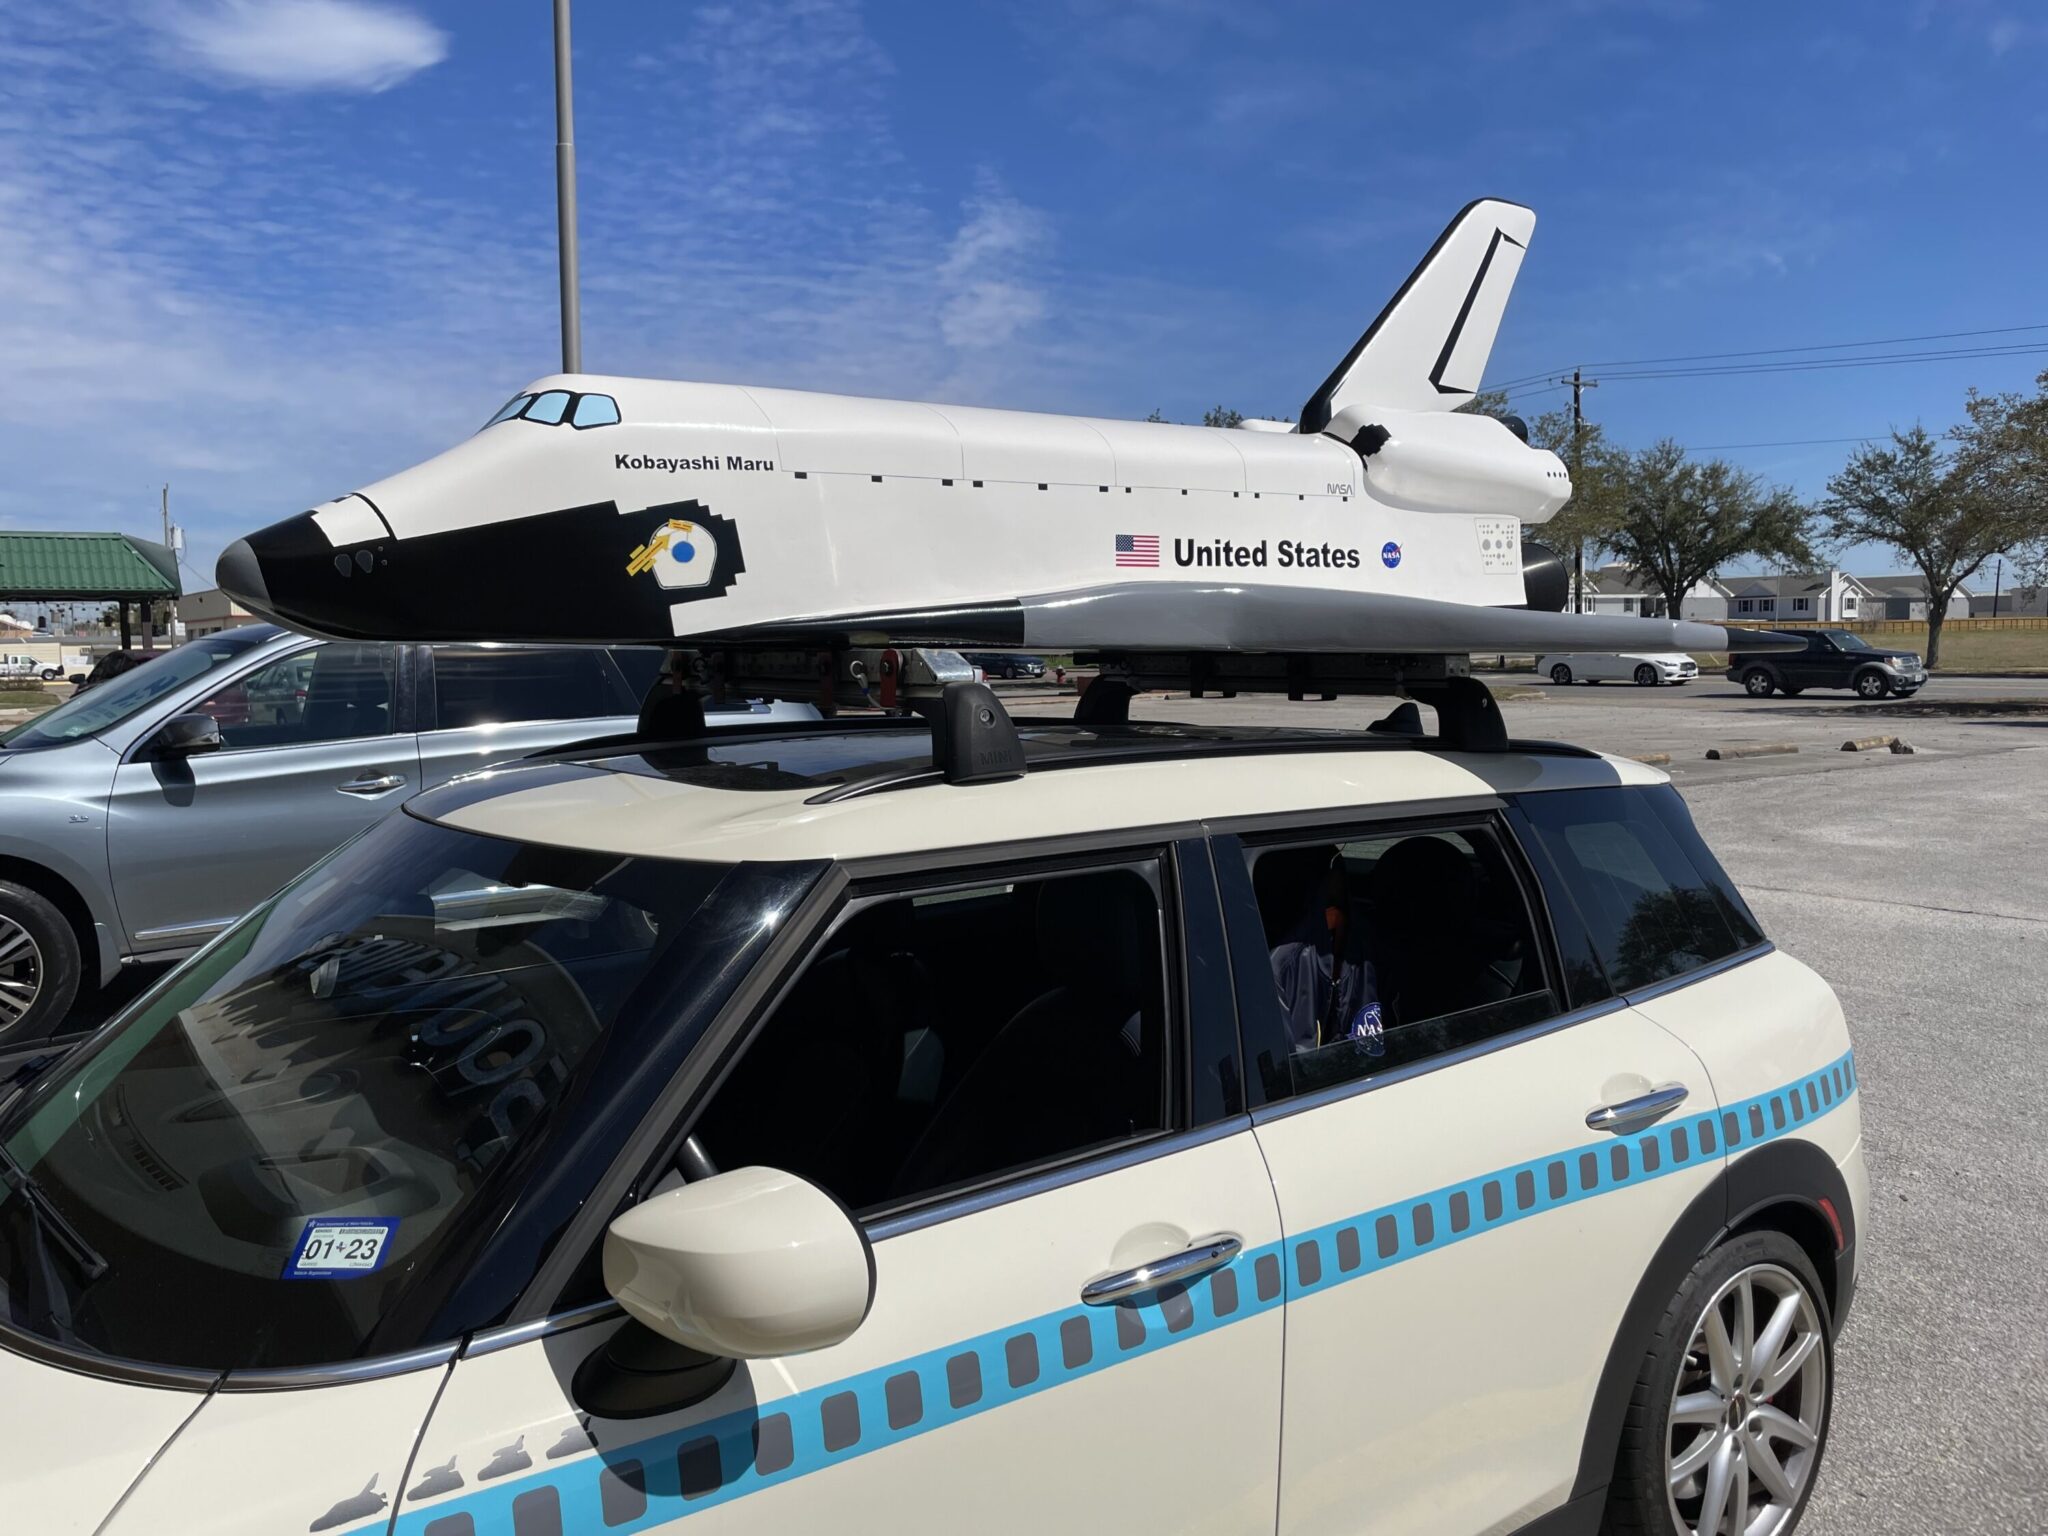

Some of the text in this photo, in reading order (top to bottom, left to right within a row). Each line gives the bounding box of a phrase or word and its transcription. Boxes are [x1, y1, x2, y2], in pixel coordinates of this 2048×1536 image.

[615, 454, 774, 473] Kobayashi Maru
[1327, 483, 1353, 495] NASA
[1174, 538, 1360, 569] United States
[1383, 551, 1400, 560] NASA
[980, 750, 1012, 766] MINI
[305, 1238, 378, 1260] 01 23
